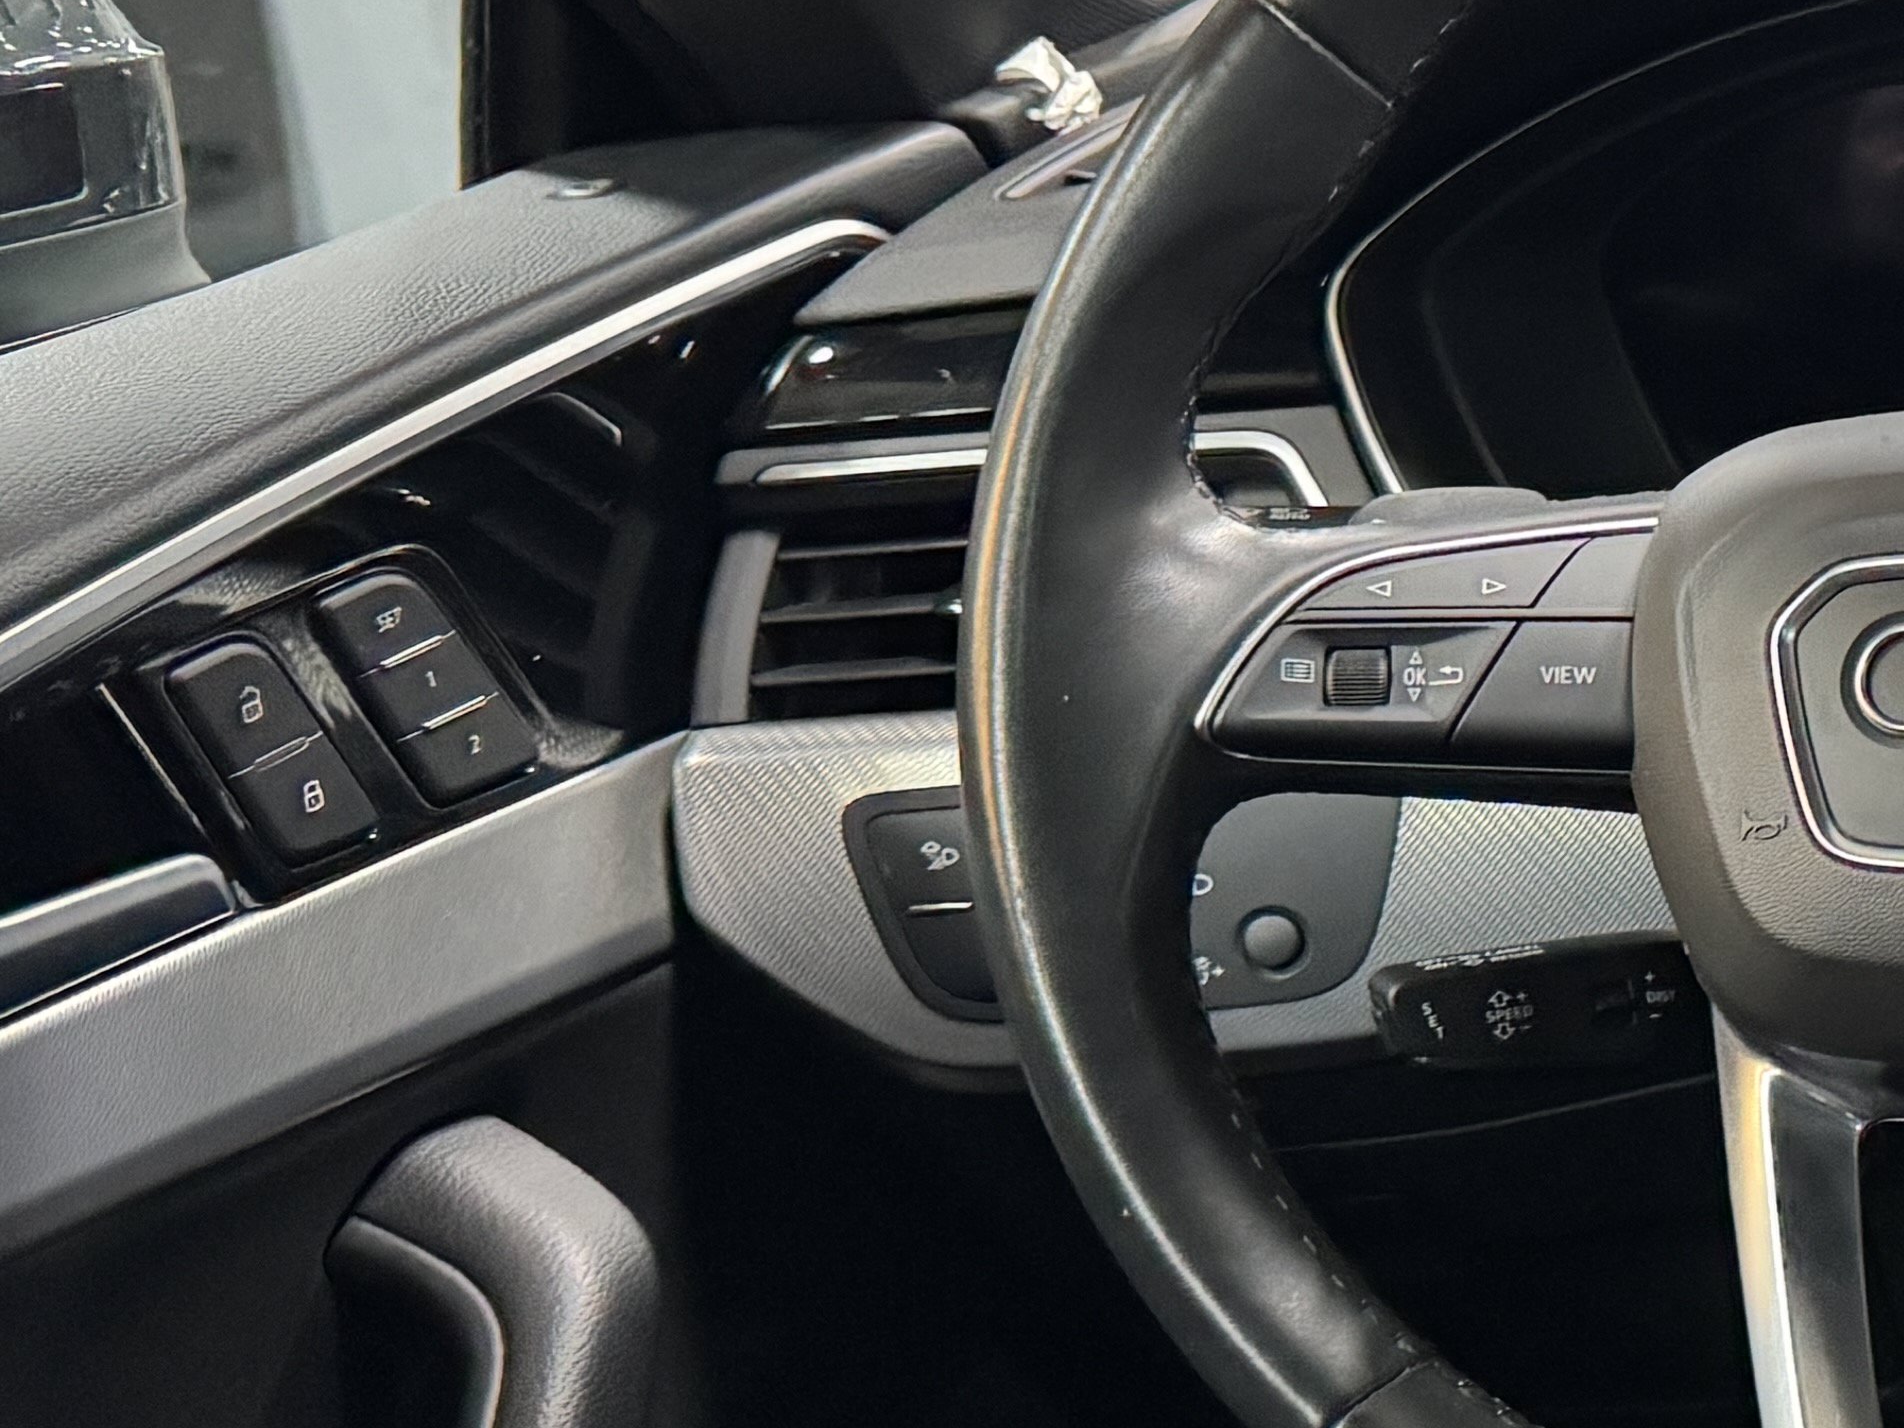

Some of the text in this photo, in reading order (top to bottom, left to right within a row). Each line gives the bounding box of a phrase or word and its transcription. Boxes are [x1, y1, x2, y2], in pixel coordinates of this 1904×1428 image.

[425, 671, 437, 688] 1
[1403, 666, 1427, 686] OK
[1539, 665, 1597, 685] VIEW
[468, 734, 482, 755] 2
[1421, 1001, 1444, 1040] SET
[1485, 1003, 1535, 1025] SPEED
